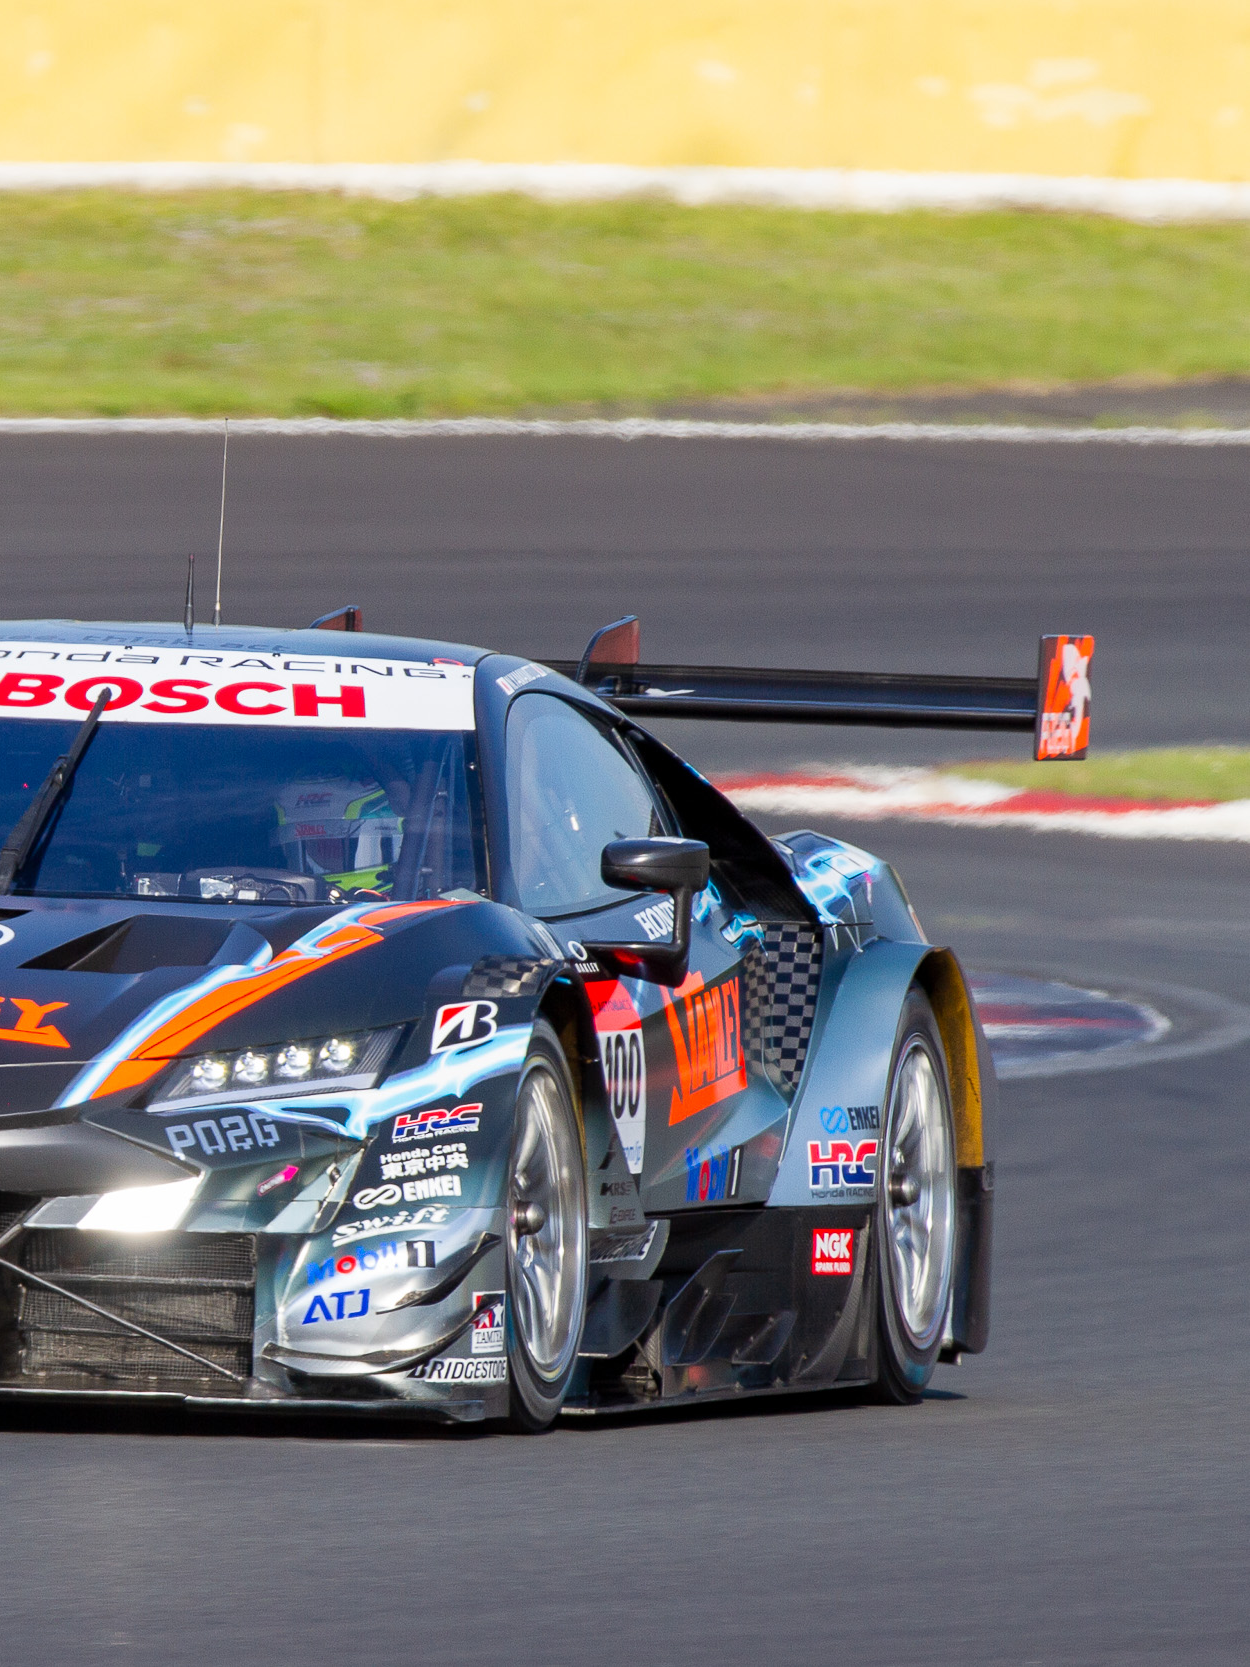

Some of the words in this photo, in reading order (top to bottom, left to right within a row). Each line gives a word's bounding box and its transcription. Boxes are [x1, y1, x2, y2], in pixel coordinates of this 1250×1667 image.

[179, 655, 447, 679] RACING
[392, 1103, 483, 1139] HRC
[847, 1106, 880, 1131] ENKEI
[379, 1148, 430, 1164] Honda
[431, 1142, 467, 1155] Cars
[380, 1152, 469, 1180] 東京中央
[807, 1139, 879, 1189] HRC
[402, 1174, 462, 1202] ENKEI
[815, 1232, 851, 1259] NGK
[306, 1240, 399, 1286] Mobil
[412, 1241, 427, 1267] 1
[301, 1288, 371, 1325] ATJ
